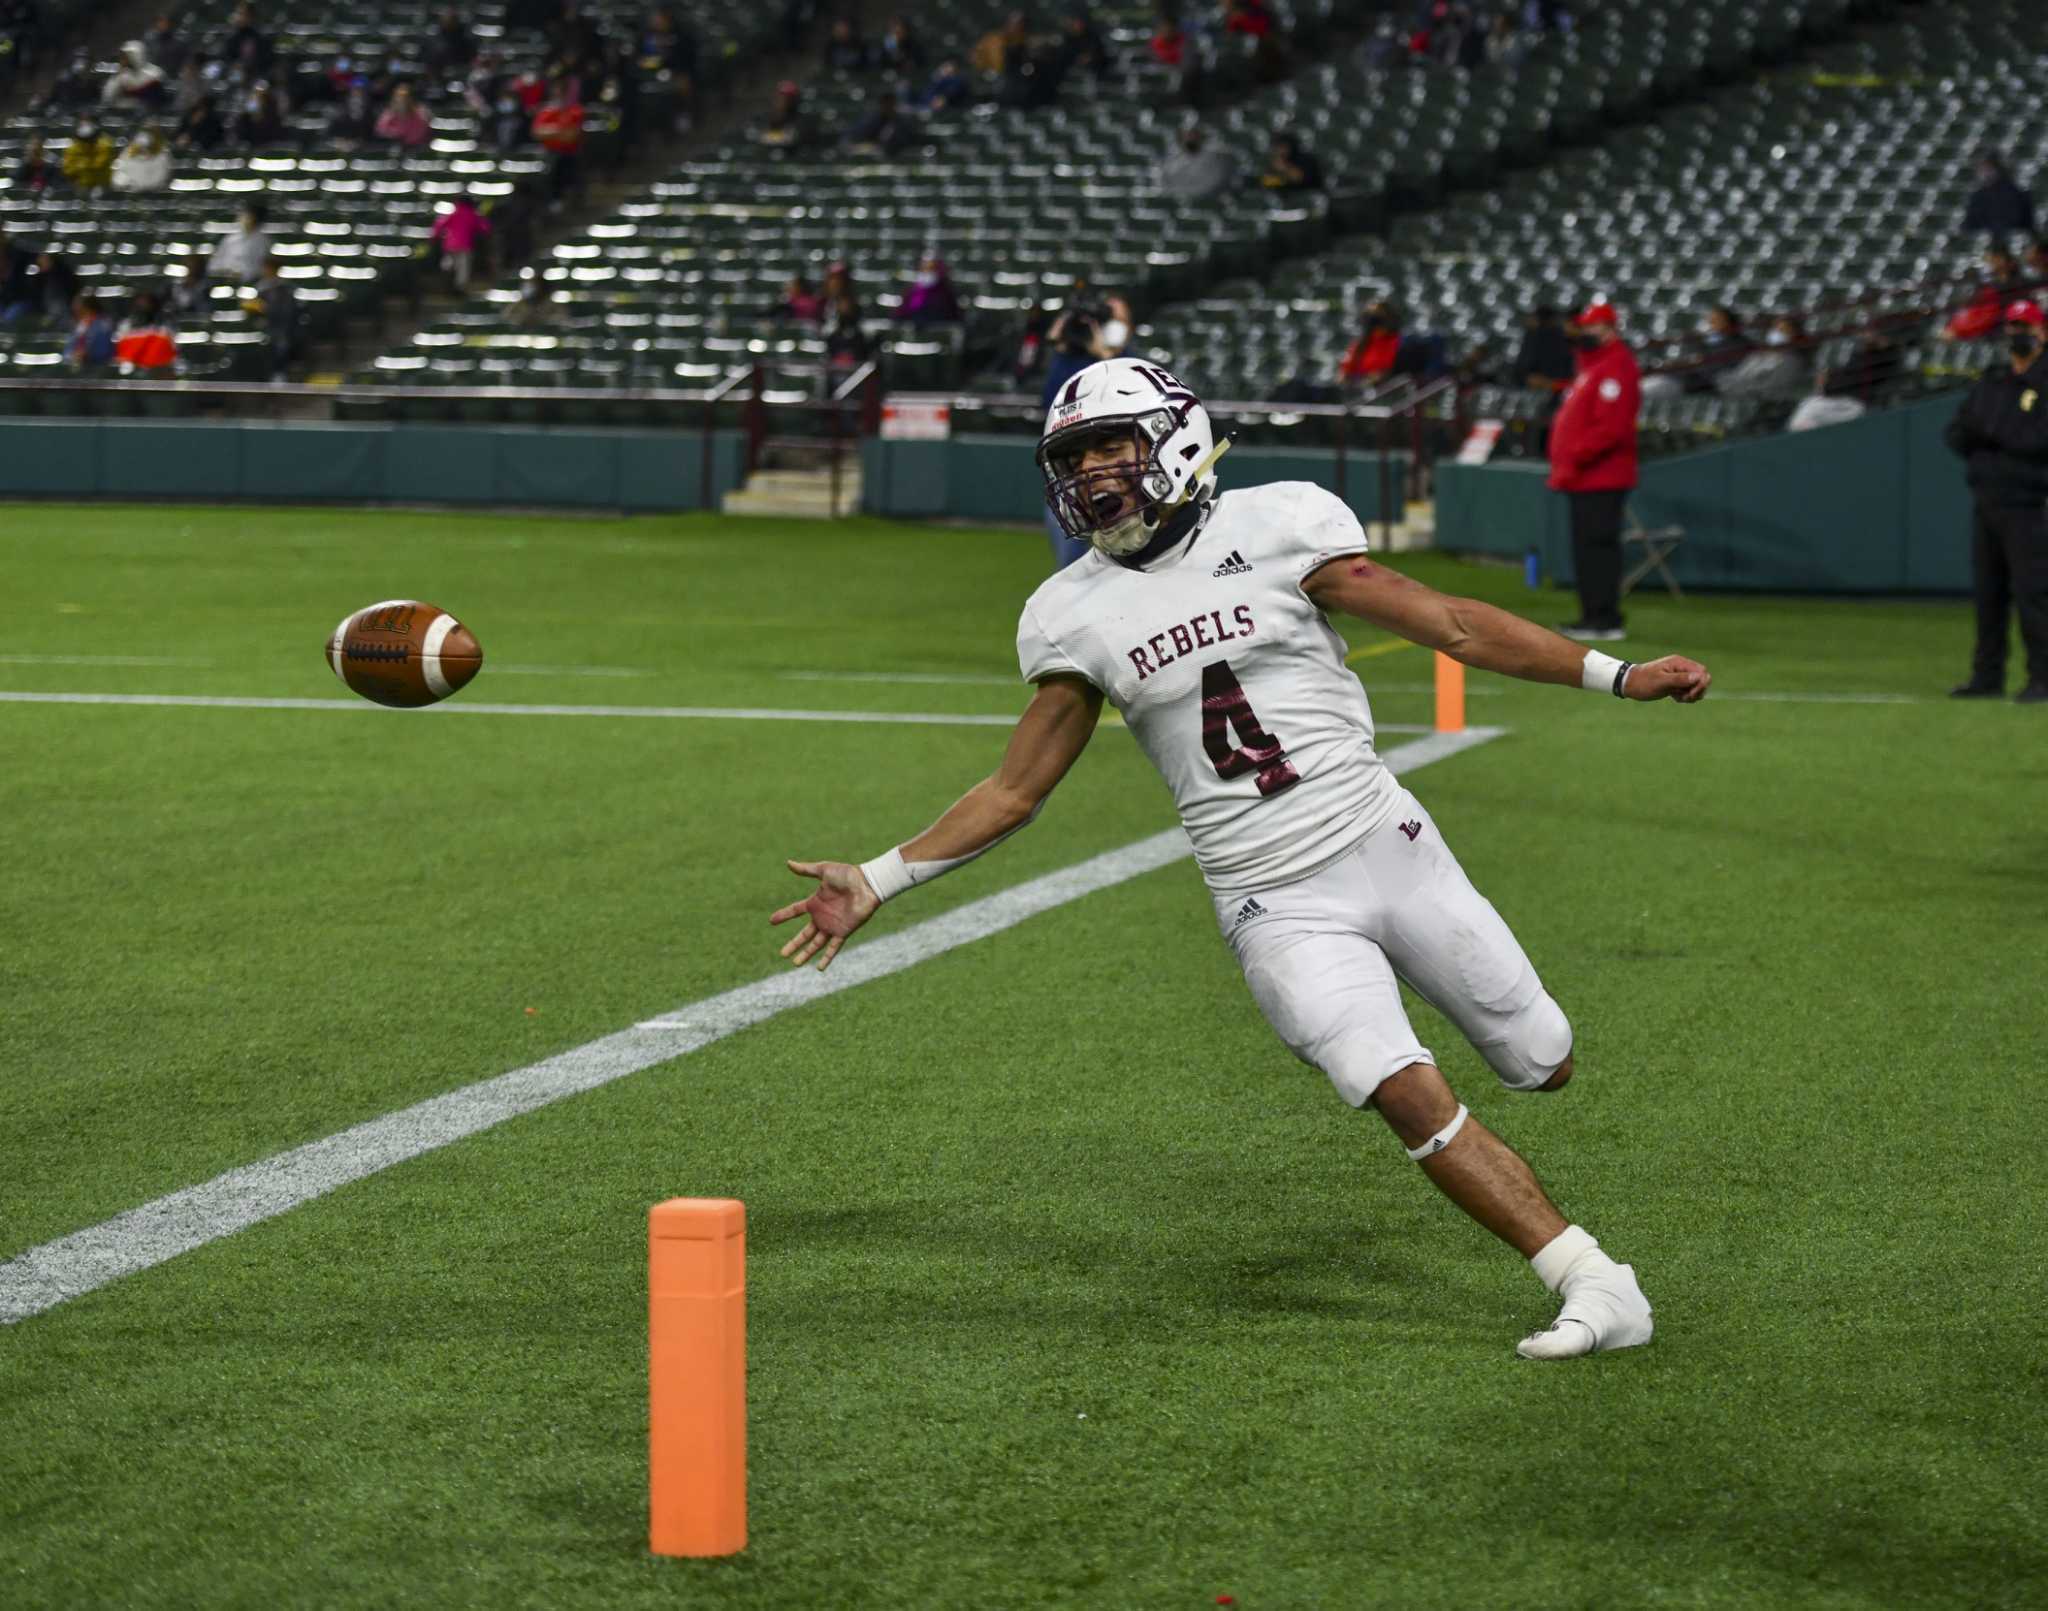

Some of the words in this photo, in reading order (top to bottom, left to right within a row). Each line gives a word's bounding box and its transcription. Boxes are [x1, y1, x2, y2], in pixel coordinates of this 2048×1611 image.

[1212, 564, 1253, 578] adidas
[1127, 605, 1256, 681] REBELS
[1201, 659, 1301, 796] 4
